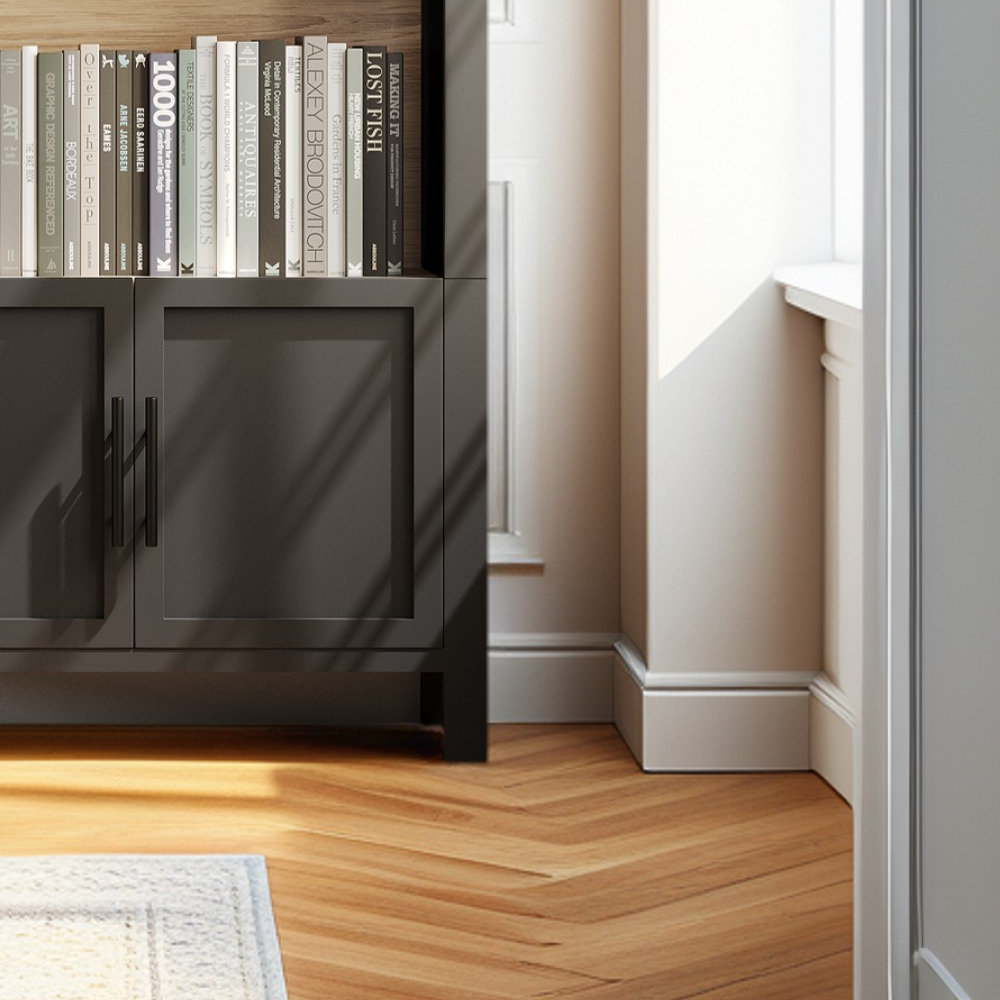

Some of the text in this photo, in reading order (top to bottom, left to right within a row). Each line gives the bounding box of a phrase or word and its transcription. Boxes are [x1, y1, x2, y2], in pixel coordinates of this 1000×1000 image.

[153, 60, 175, 127] 1000
[263, 61, 271, 87] Virginia
[273, 61, 281, 80] Detail
[307, 43, 324, 122] ALEXEY
[366, 52, 382, 153] LOST FISH
[390, 63, 399, 137] MAKING IT
[2, 104, 18, 140] ART
[103, 124, 111, 152] EAMES
[136, 108, 144, 172] EERO SAARINEN
[199, 95, 212, 142] BOOK
[46, 73, 55, 235] GRAPHIC DESIGN REFERENCED
[66, 142, 77, 200] BORDEAUX
[242, 101, 256, 218] ANTIQUAIRES
[332, 114, 341, 215] Gardens in France
[199, 161, 212, 245] SYMBOLS
[307, 130, 324, 263] BRODOVITCH
